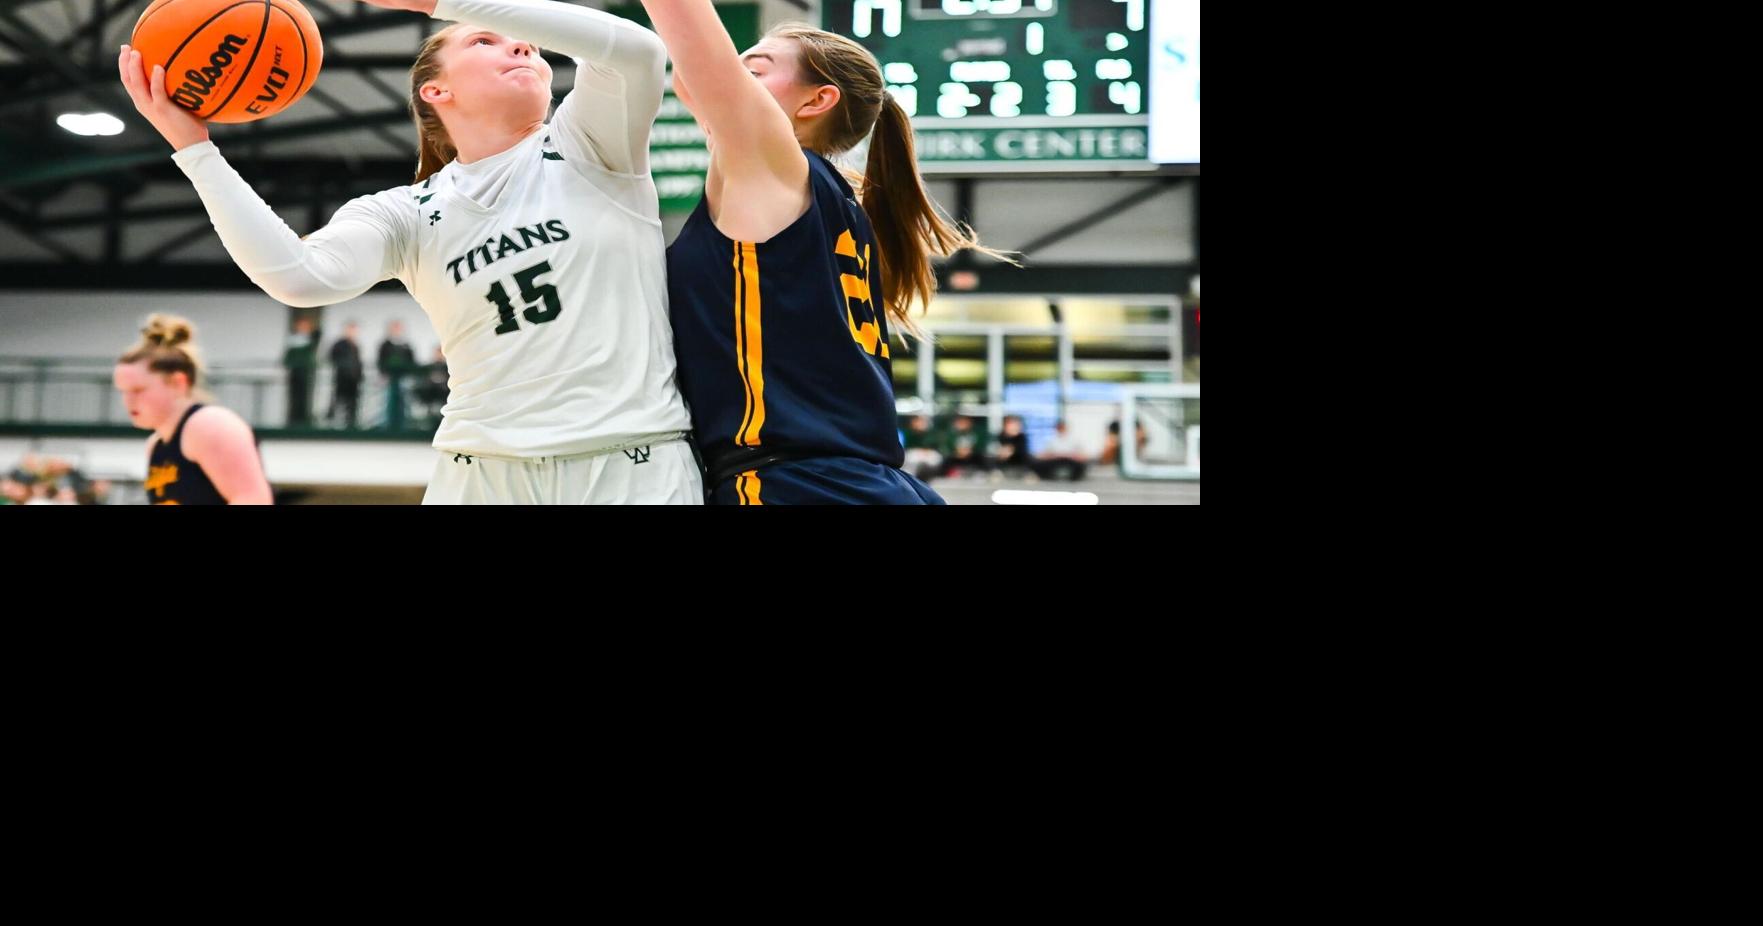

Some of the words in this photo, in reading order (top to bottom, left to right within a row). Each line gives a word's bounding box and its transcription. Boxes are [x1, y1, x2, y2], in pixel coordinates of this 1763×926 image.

[171, 34, 248, 111] Wilson
[245, 66, 290, 114] EVO
[993, 129, 1147, 159] CENTER
[446, 219, 570, 287] TITANS
[485, 260, 563, 335] 15
